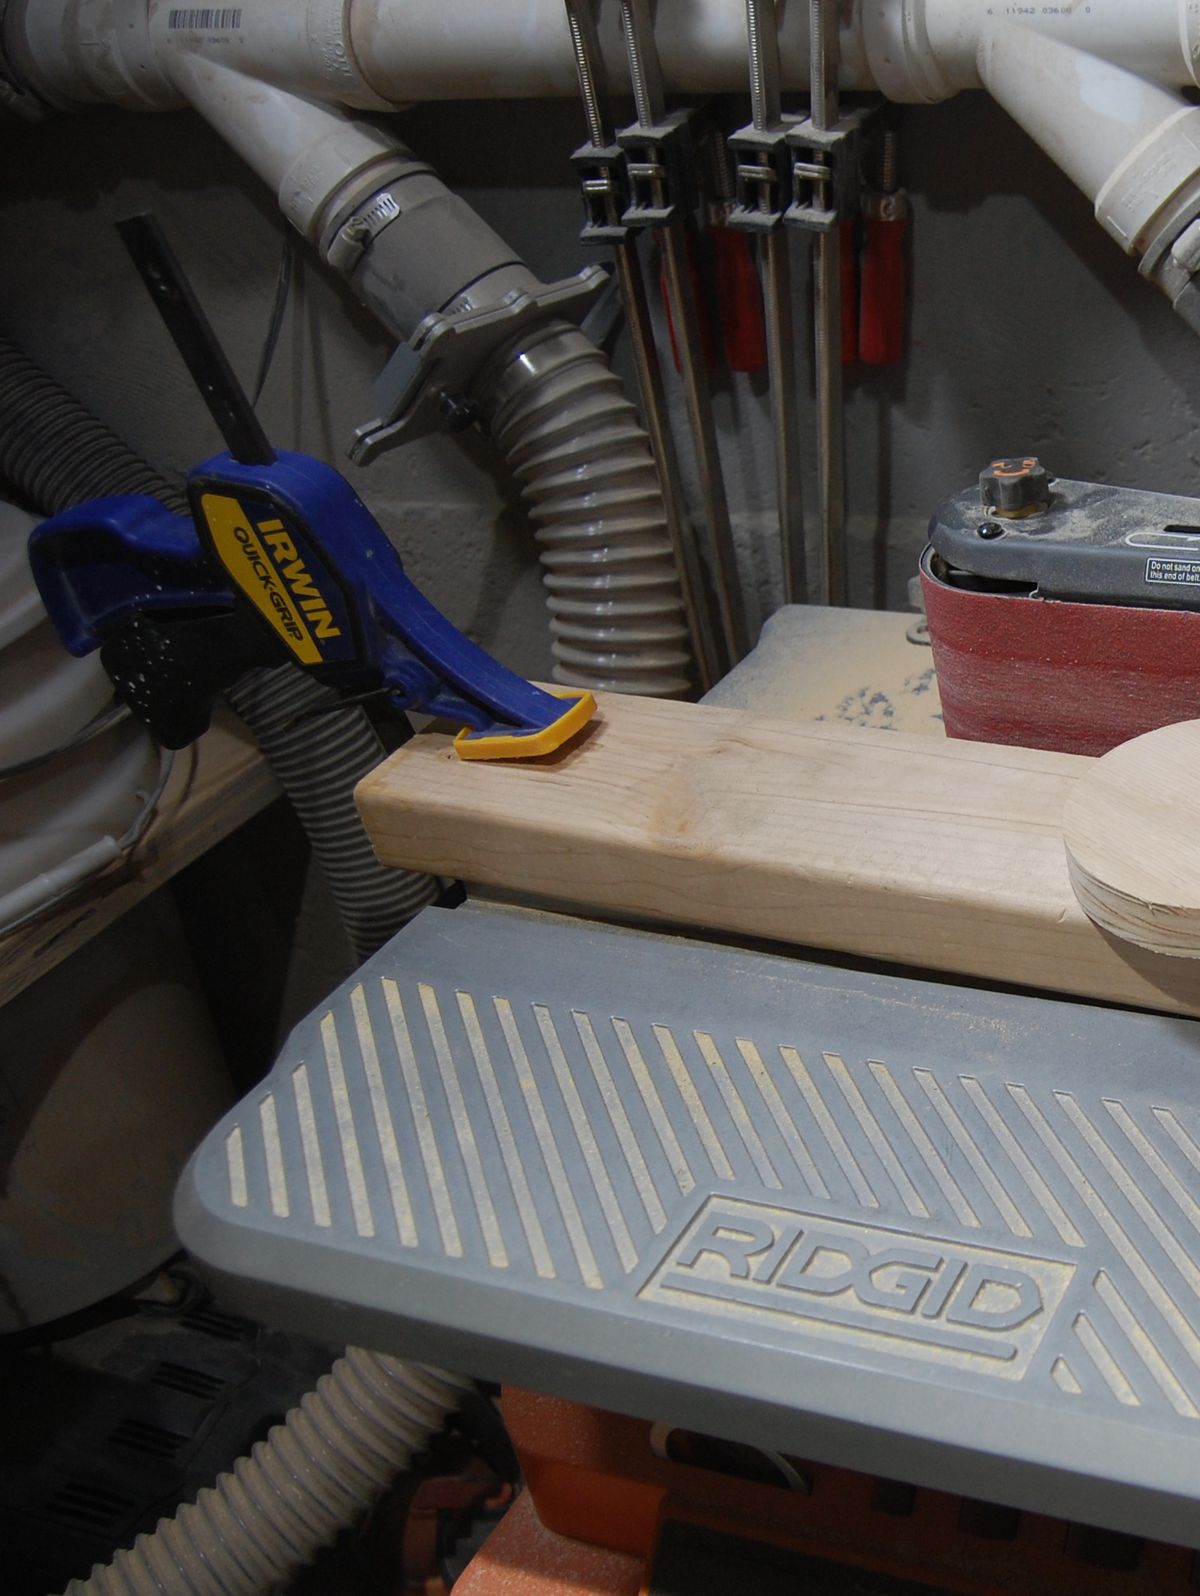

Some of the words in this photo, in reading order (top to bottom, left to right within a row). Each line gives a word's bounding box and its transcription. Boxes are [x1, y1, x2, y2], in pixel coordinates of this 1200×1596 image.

[257, 519, 341, 639] IRWIN
[1150, 570, 1162, 580] this
[1178, 573, 1185, 581] of
[1186, 574, 1200, 582] belt.
[1151, 561, 1160, 570] Do
[1162, 562, 1173, 572] not
[1174, 563, 1192, 572] sand
[1192, 564, 1200, 573] on
[676, 1210, 1044, 1332] RIDGID
